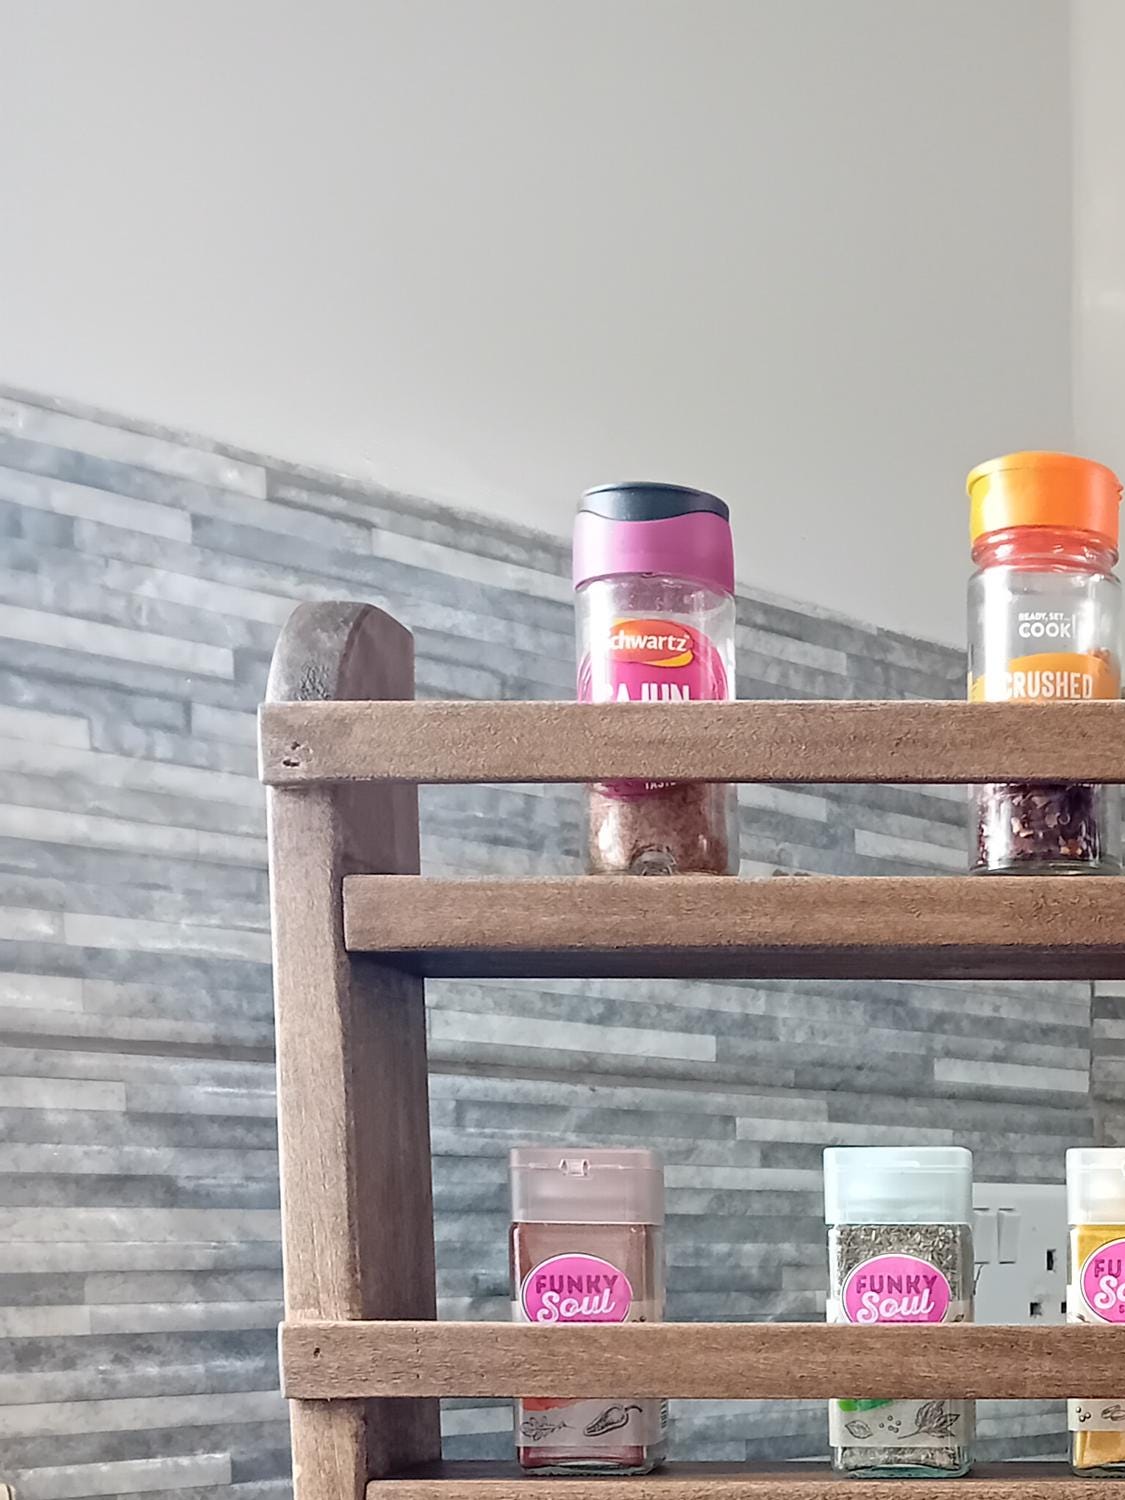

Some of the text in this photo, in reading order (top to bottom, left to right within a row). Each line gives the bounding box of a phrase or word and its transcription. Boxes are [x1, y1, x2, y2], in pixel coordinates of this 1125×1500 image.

[607, 629, 687, 652] chwartz
[535, 1274, 618, 1294] FUNKY
[856, 1274, 938, 1294] FUNKY
[536, 1287, 616, 1322] Soul
[856, 1288, 934, 1323] Soul
